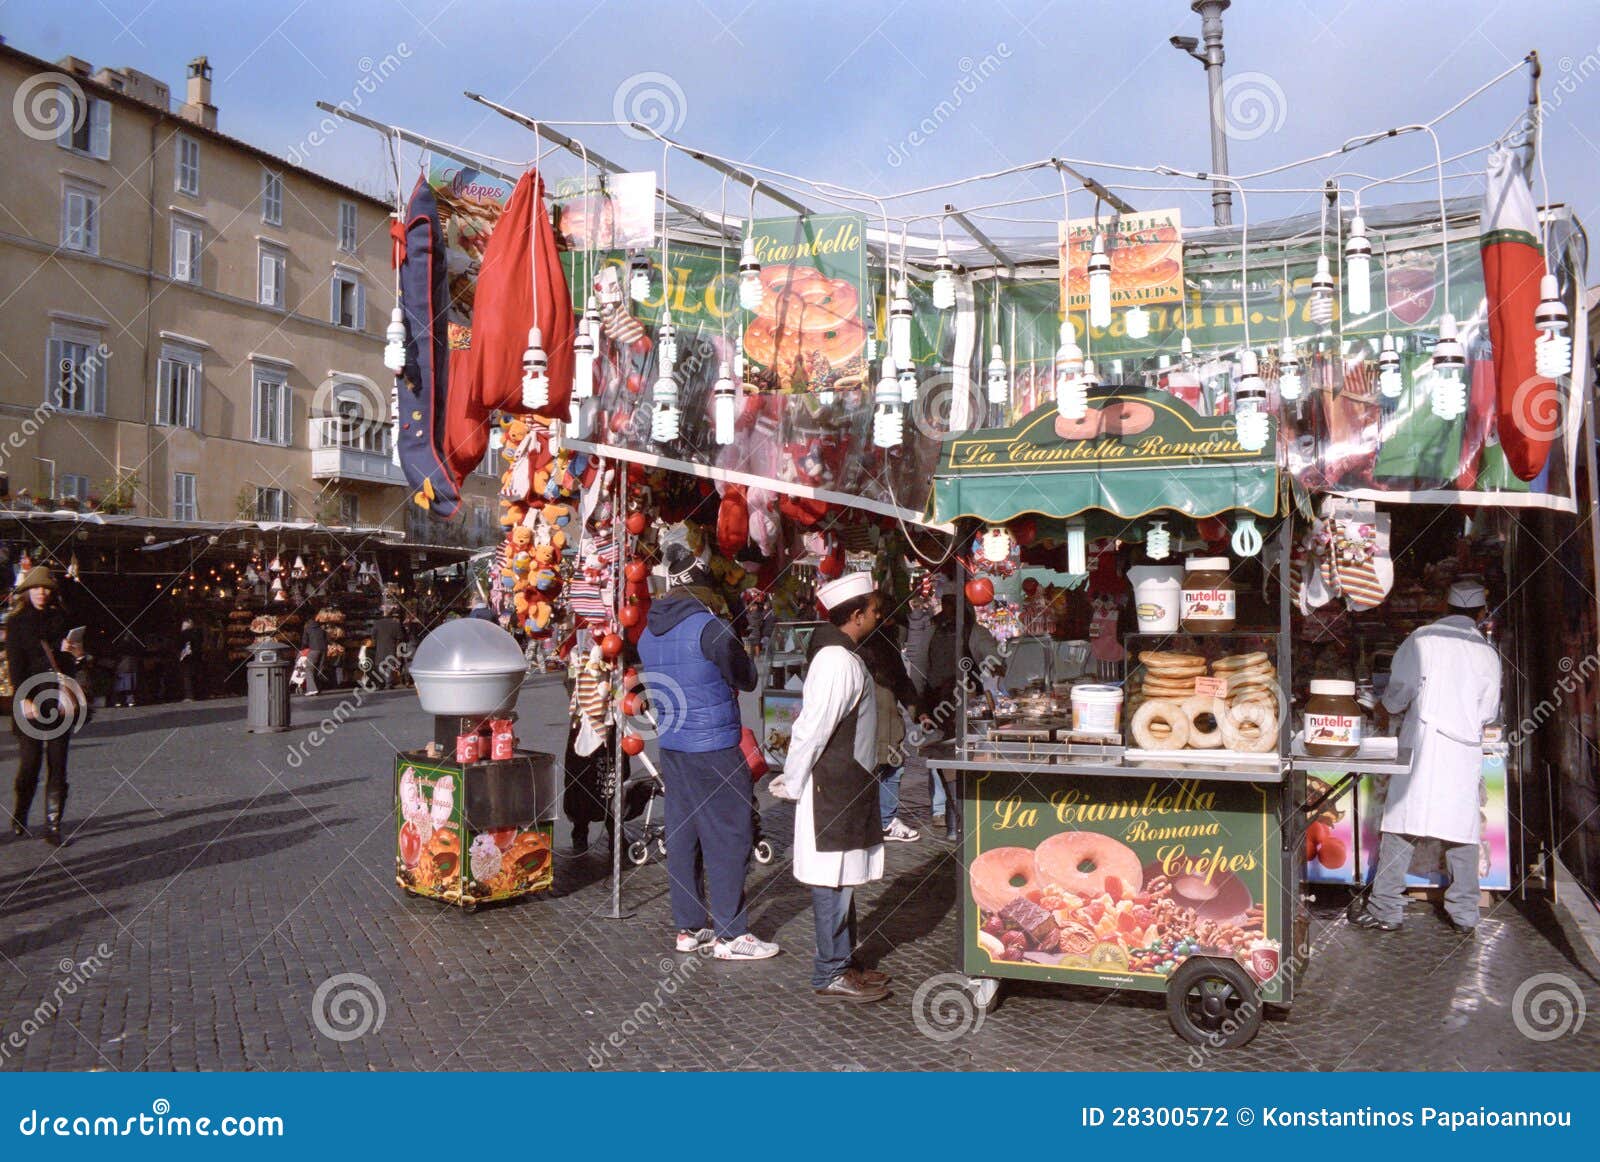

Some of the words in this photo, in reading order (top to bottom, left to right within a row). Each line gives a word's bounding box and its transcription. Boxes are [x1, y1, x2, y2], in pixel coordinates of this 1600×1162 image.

[441, 168, 504, 200] Crêpes
[752, 223, 861, 263] Ciambelle
[961, 443, 997, 465] La
[1007, 438, 1126, 463] Ciambella
[1185, 589, 1227, 602] nutella
[1310, 714, 1353, 728] nutella
[992, 795, 1039, 832] La
[1050, 780, 1217, 825] Ciambella
[1126, 819, 1221, 843] Romana
[1156, 844, 1257, 887] Crêpes
